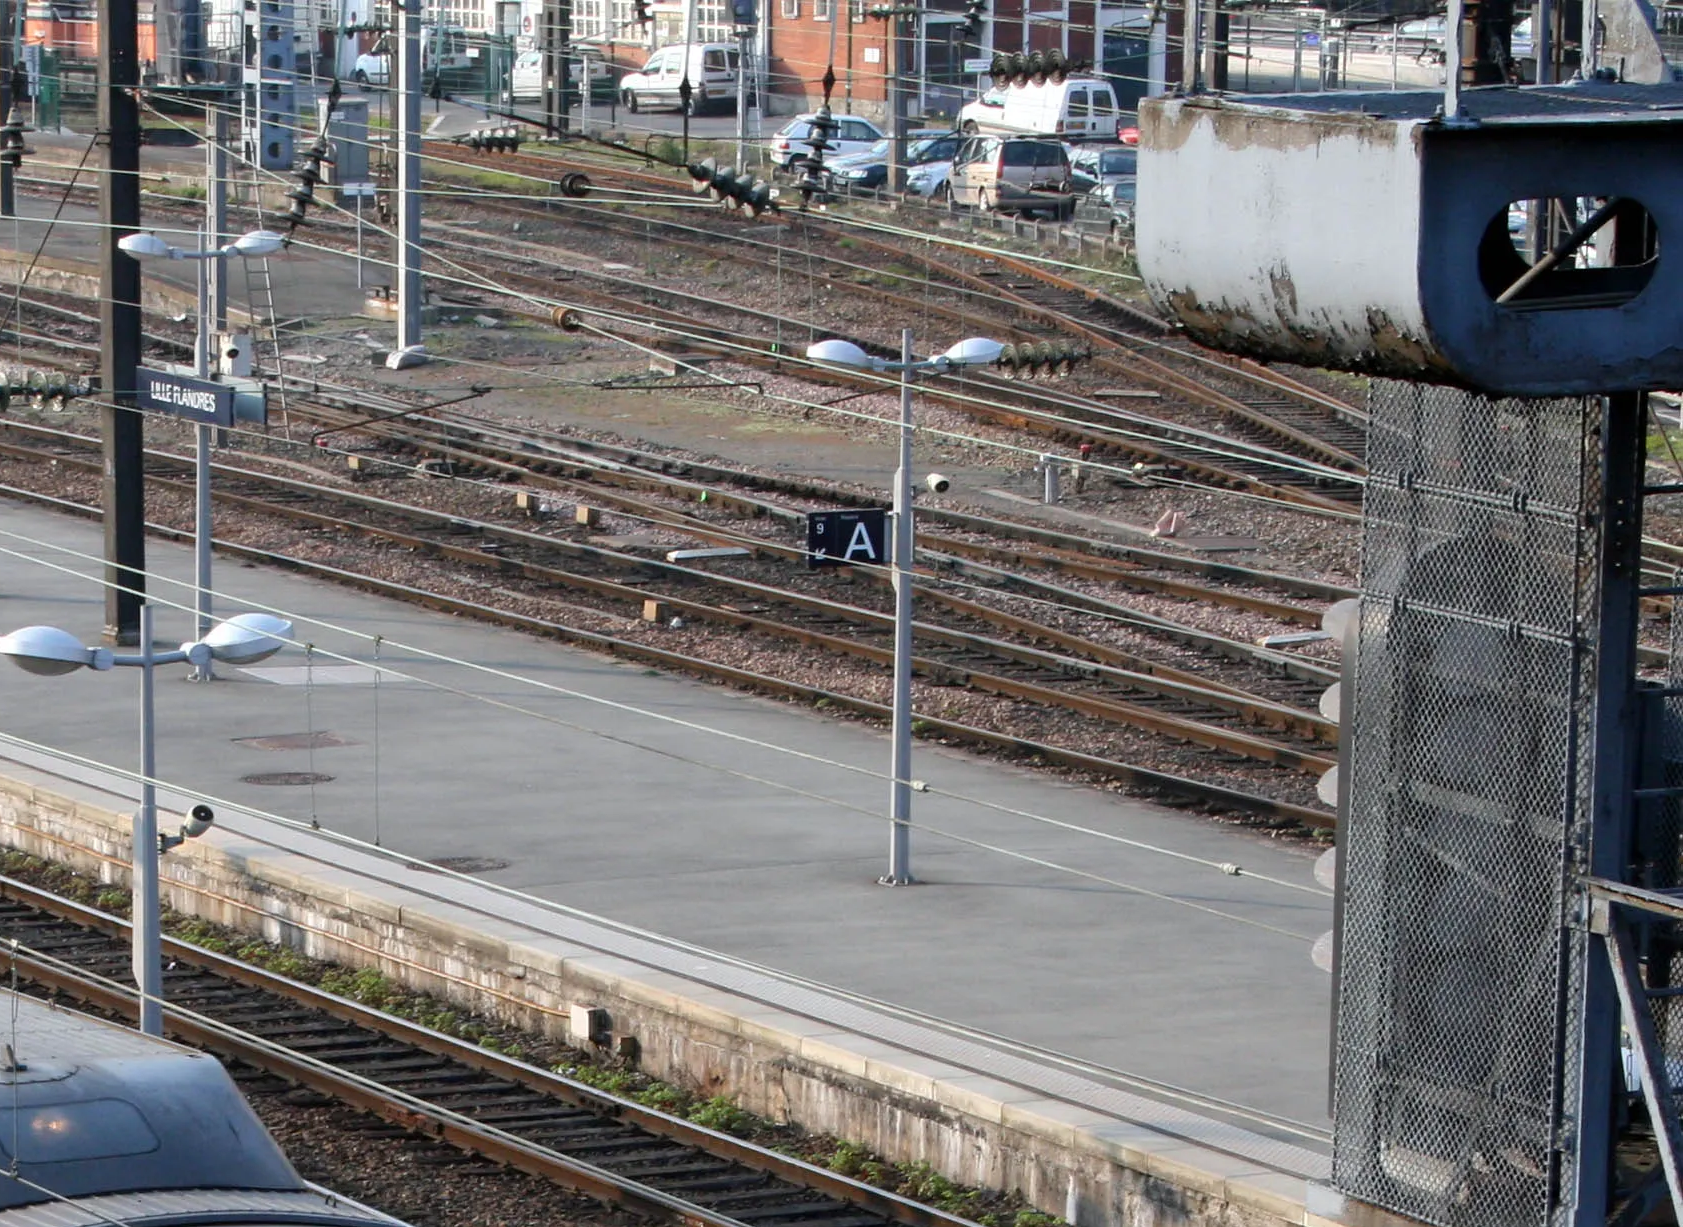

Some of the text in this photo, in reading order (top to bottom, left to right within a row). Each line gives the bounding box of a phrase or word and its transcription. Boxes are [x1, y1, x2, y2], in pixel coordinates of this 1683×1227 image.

[150, 380, 216, 413] LILLE FLANDRES
[816, 522, 825, 535] 9
[844, 522, 876, 560] A
